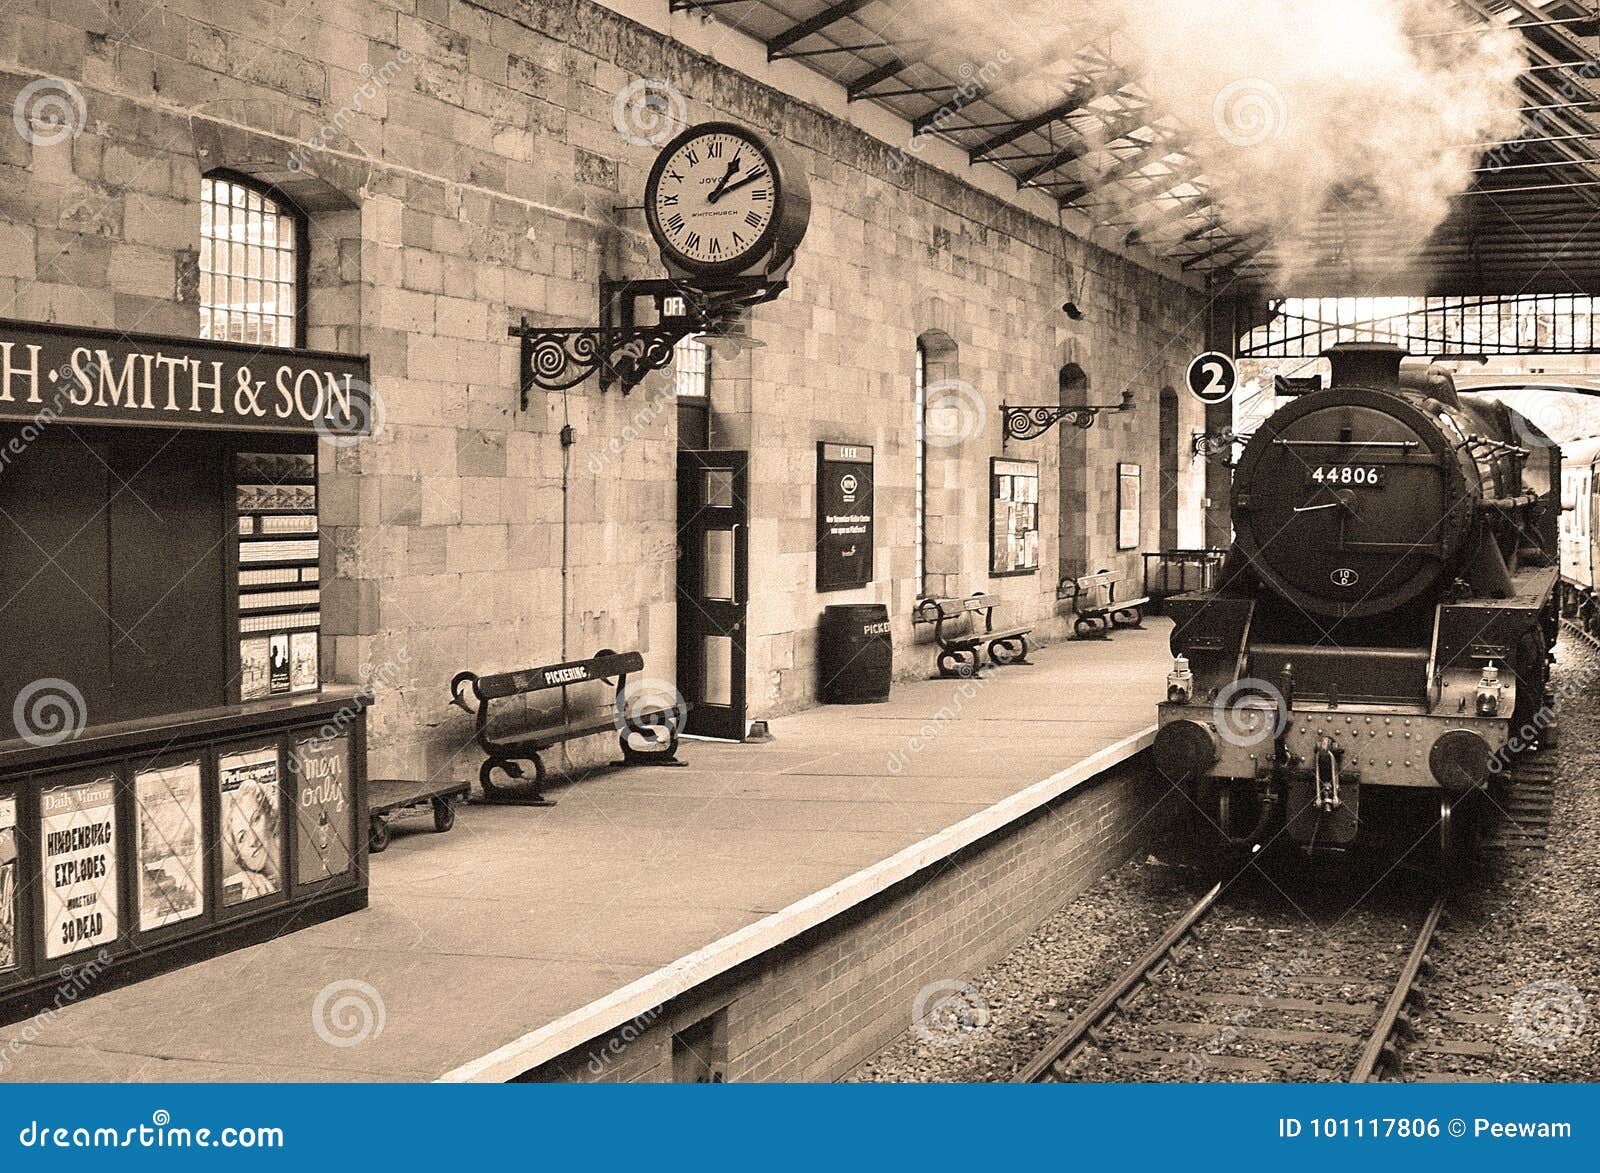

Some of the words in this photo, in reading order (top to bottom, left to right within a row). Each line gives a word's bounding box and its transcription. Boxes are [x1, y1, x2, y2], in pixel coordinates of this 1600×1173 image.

[663, 297, 686, 316] OFF
[70, 346, 224, 414] SMITH
[233, 366, 267, 417] &
[275, 365, 354, 421] SON
[1201, 362, 1226, 394] 2
[1312, 466, 1378, 484] 44806
[1340, 570, 1350, 578] 10
[1341, 577, 1348, 585] D
[544, 666, 588, 685] PICKERING
[303, 755, 343, 780] men
[45, 791, 72, 811] Daily
[76, 786, 110, 803] Mirror
[302, 776, 345, 812] only
[47, 821, 112, 857] HINDENBURG
[55, 854, 106, 888] EXPLODES
[67, 895, 82, 911] MORE
[83, 892, 97, 906] THAN
[62, 920, 75, 945] 30
[76, 912, 103, 941] DEAD
